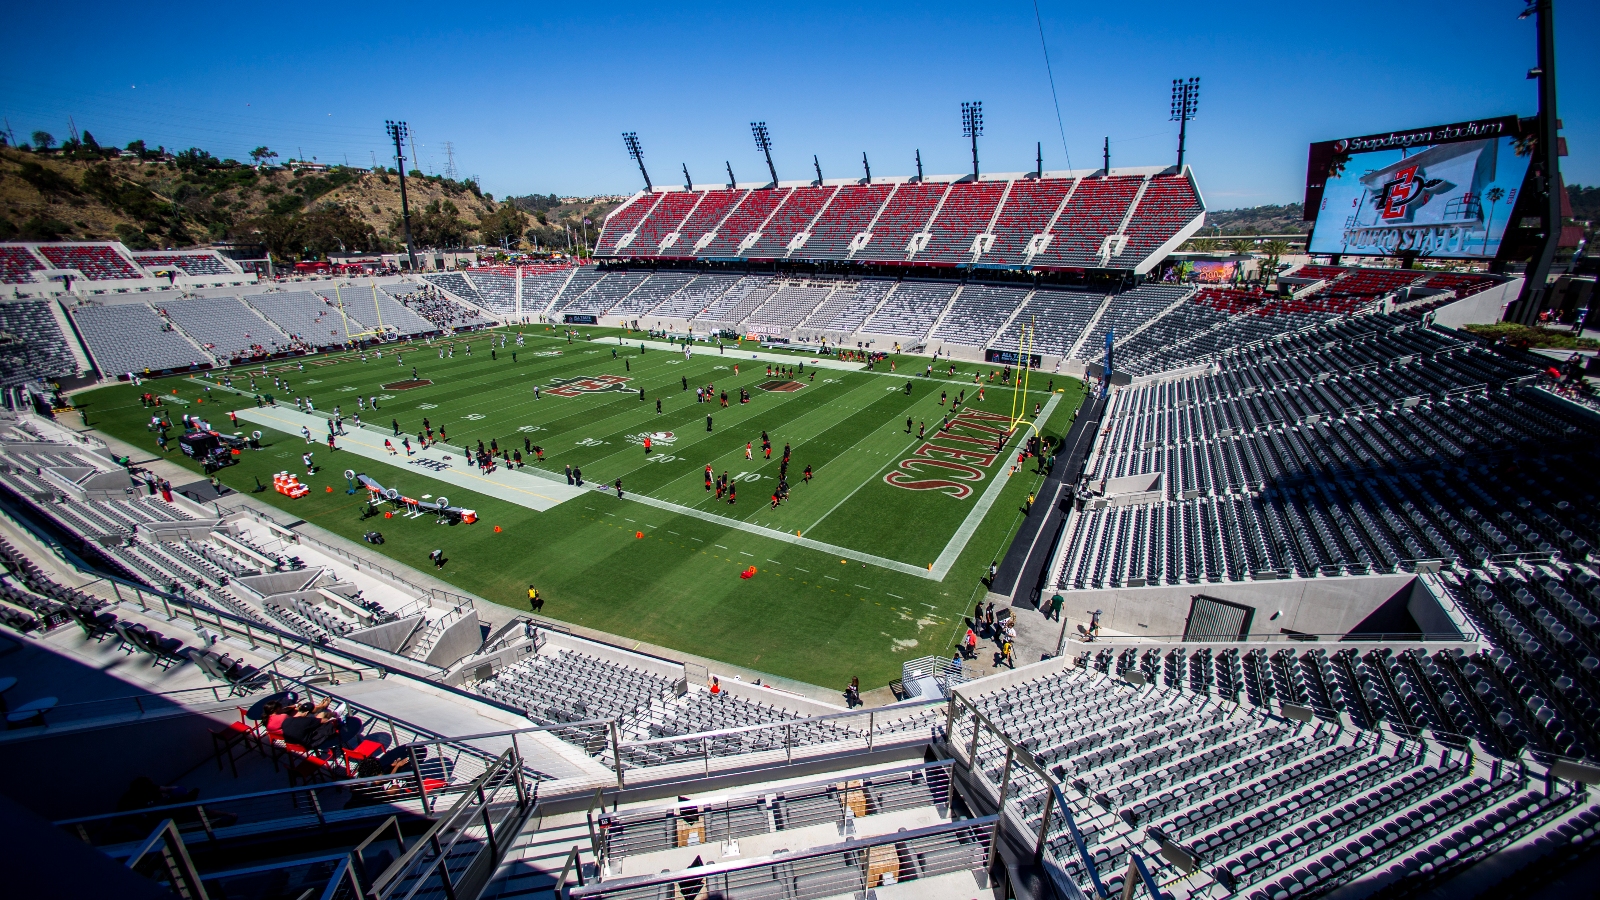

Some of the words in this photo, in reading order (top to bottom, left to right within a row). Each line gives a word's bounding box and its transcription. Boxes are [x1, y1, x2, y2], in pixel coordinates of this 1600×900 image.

[1350, 132, 1432, 150] Snapdragon
[1435, 122, 1503, 140] stadium
[1399, 226, 1474, 253] STATE
[646, 453, 676, 464] 20
[732, 471, 762, 483] 10
